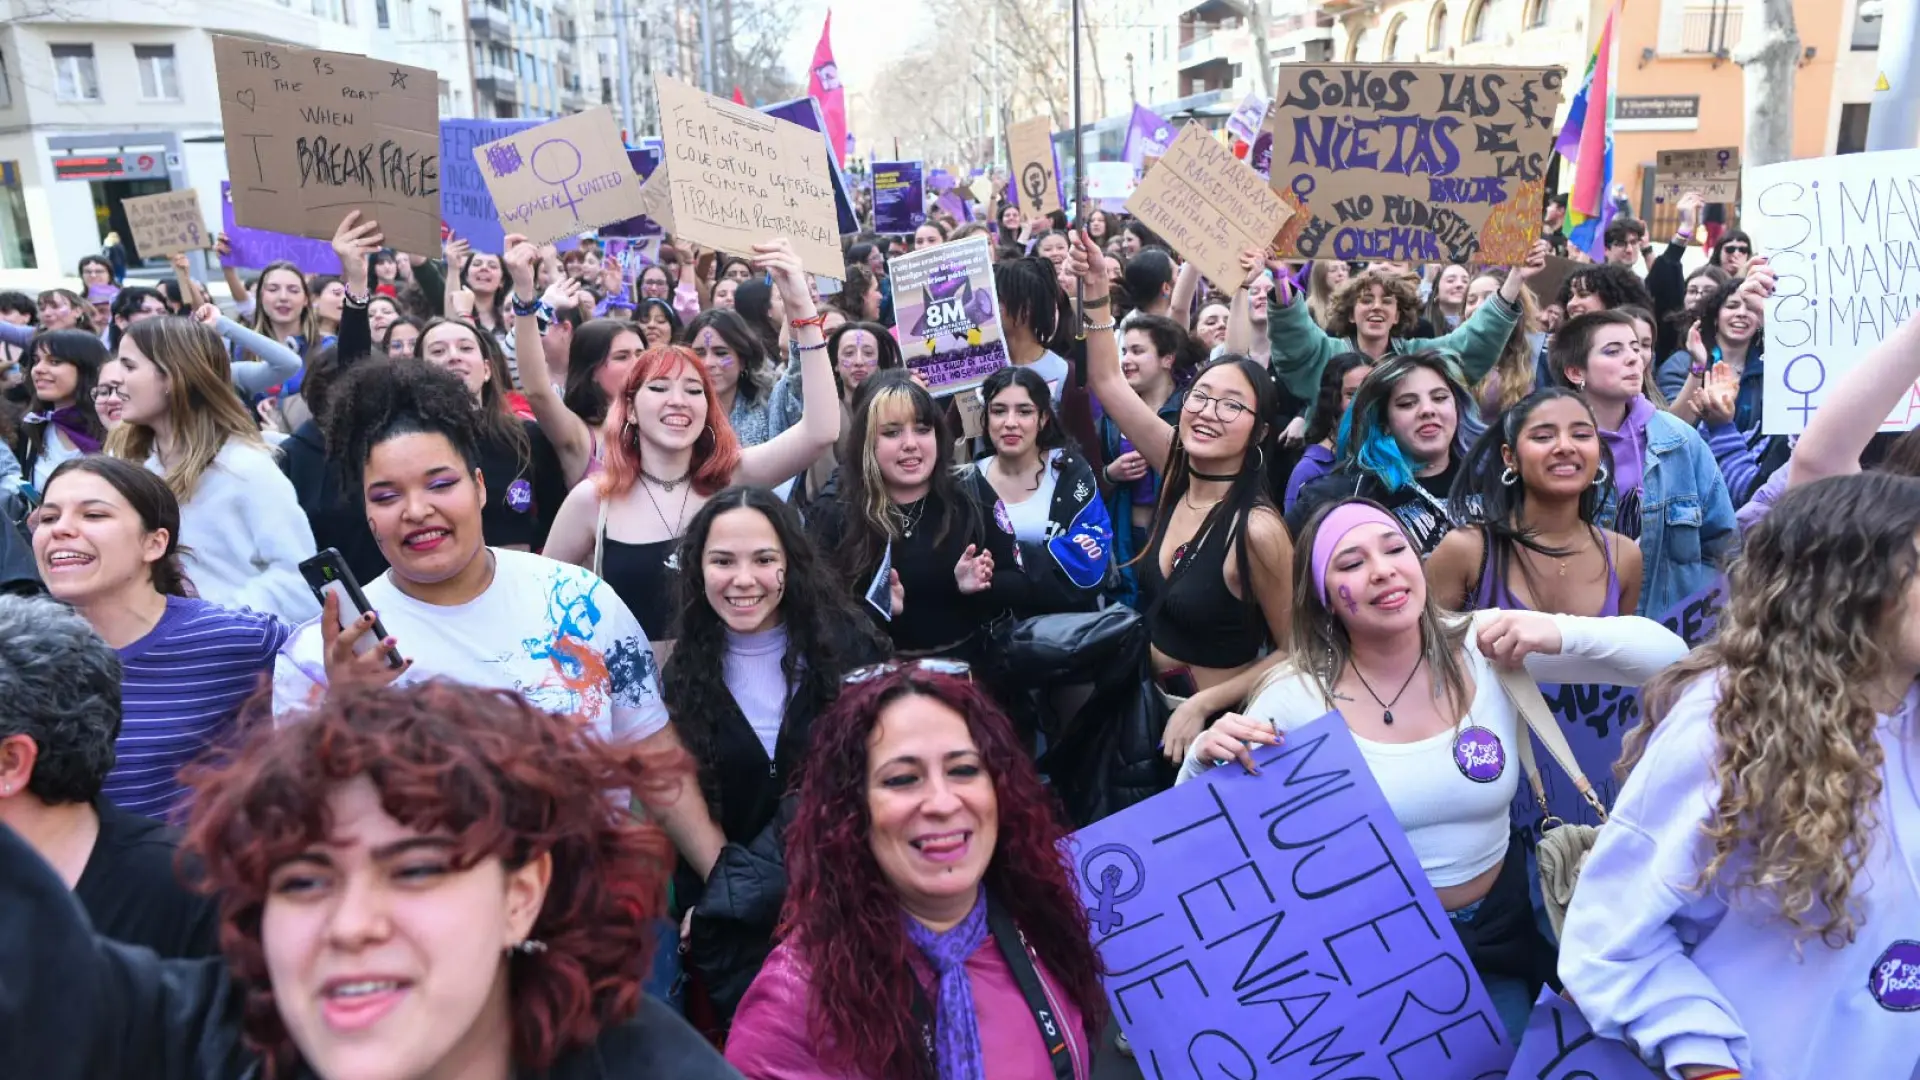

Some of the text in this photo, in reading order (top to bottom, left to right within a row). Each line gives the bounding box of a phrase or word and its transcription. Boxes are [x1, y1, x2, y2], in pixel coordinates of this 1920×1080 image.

[274, 78, 380, 101] THE PART
[1280, 69, 1508, 118] SOMOS LAS
[300, 106, 354, 125] WHEN
[1473, 121, 1519, 154] DE
[241, 134, 440, 198] I BREAK FREE
[800, 155, 811, 171] Y
[1496, 152, 1543, 181] LAS
[503, 190, 562, 225] WOMEN
[577, 171, 622, 197] UNITED
[702, 170, 799, 208] CONTRA LA
[1428, 176, 1508, 206] BRUJAS
[1331, 194, 1374, 223] NO
[1138, 196, 1211, 261] PATRIARCAL
[1332, 226, 1441, 261] QUEMAR
[926, 299, 967, 327] 8M
[1260, 732, 1508, 1080] MUJERE
[1152, 783, 1381, 1080] TENÍAM
